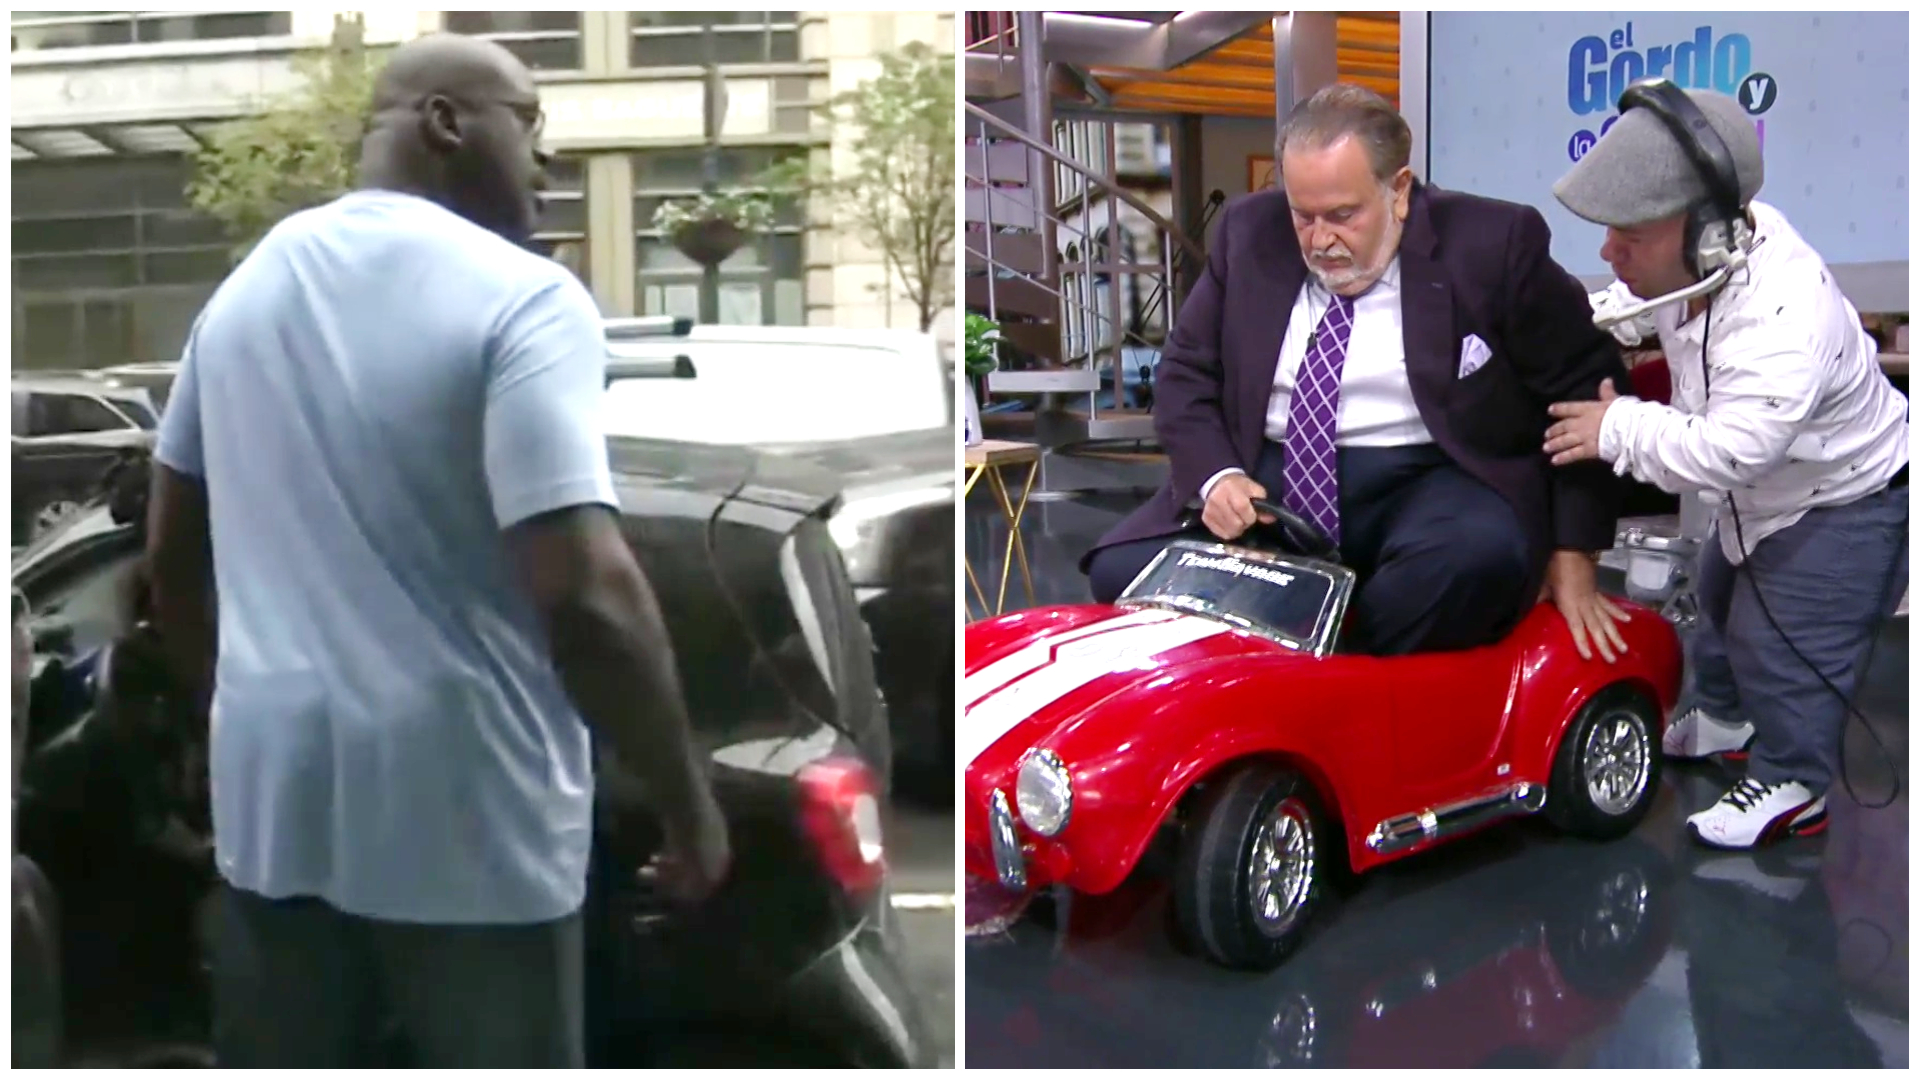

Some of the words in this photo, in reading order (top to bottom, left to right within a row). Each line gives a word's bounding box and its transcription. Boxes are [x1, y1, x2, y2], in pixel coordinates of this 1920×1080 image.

[1609, 21, 1634, 50] el
[1568, 26, 1751, 116] Gordo
[1749, 78, 1769, 110] y
